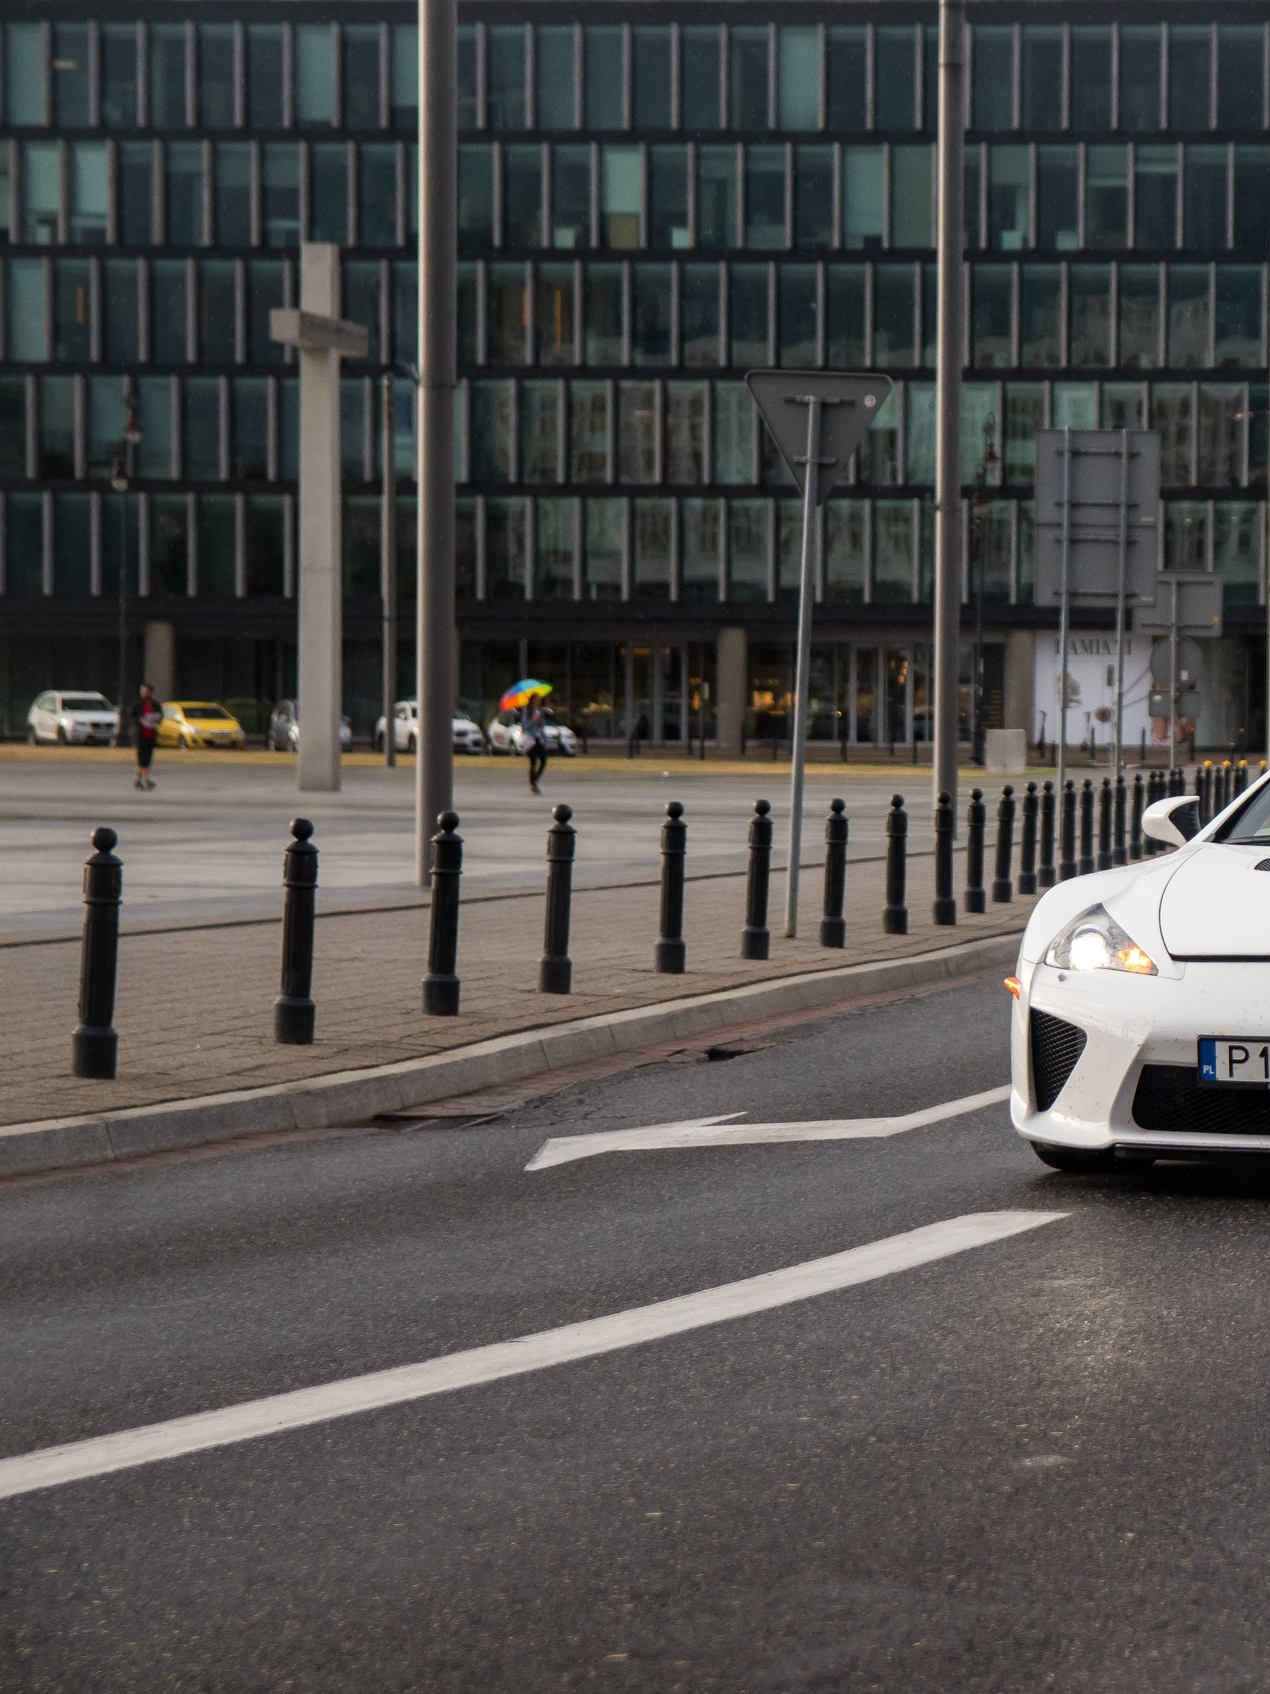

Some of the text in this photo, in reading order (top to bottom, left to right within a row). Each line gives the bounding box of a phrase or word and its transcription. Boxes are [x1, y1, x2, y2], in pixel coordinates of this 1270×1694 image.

[1054, 637, 1132, 655] AMIAI
[1203, 1065, 1215, 1075] PL
[1228, 1045, 1269, 1079] P1
